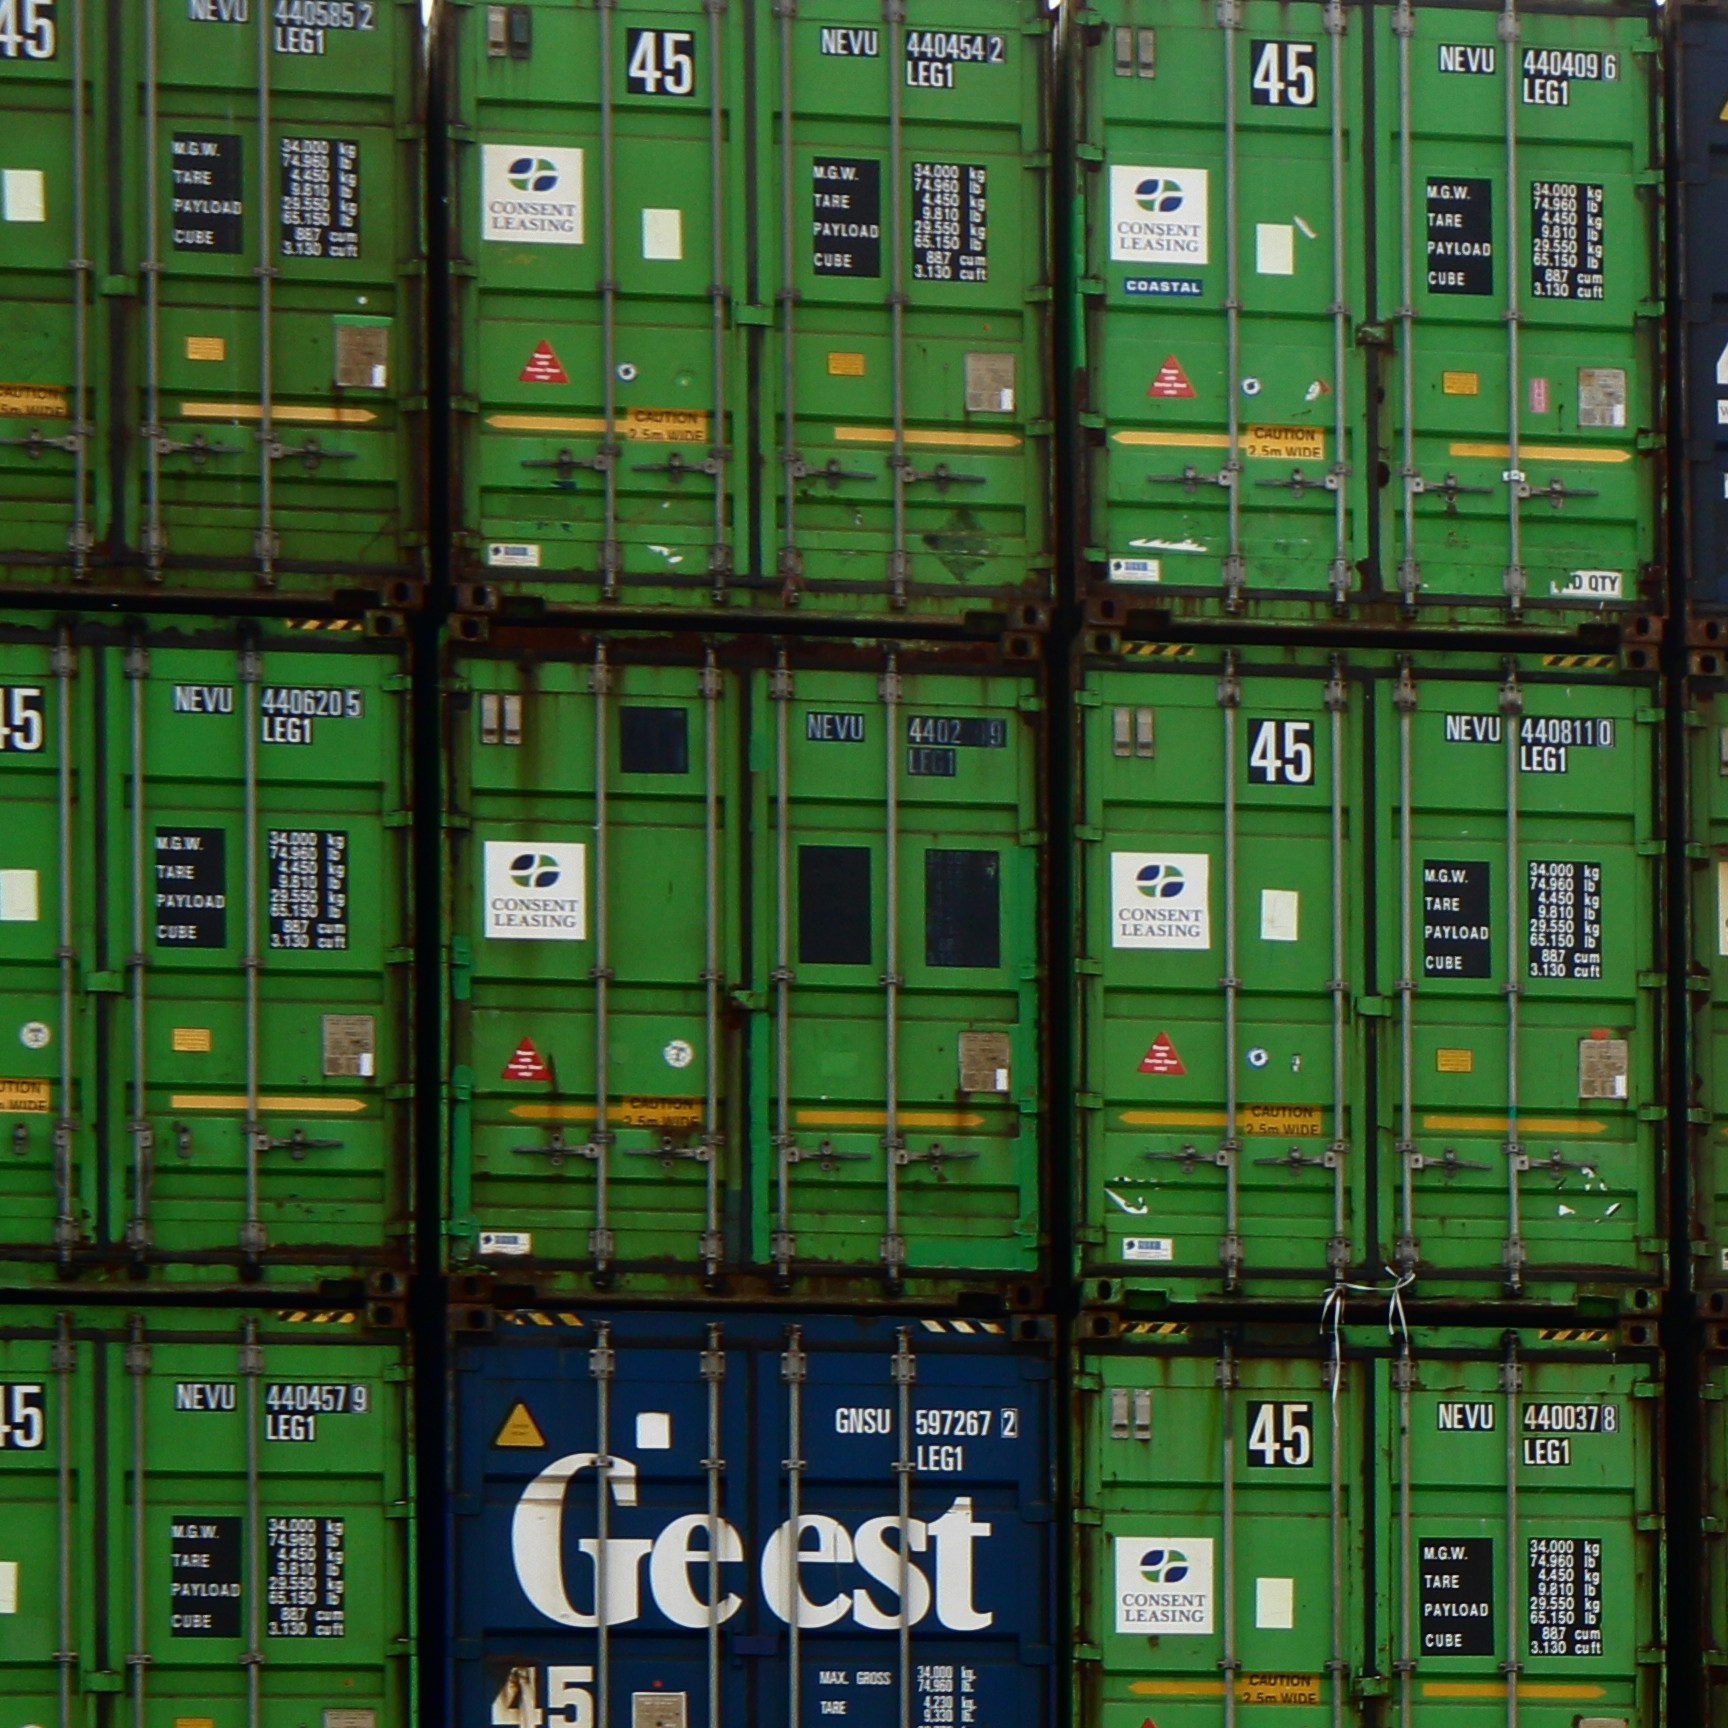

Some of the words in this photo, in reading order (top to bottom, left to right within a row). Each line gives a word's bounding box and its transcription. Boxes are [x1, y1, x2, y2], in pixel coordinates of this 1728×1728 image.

[823, 29, 877, 54] NEVU
[908, 33, 983, 64] 440454
[630, 32, 690, 93] 45
[908, 61, 952, 87] LEG1
[1254, 44, 1313, 104] 45
[1441, 46, 1493, 72] NEVU
[1525, 51, 1597, 80] 440409
[1524, 78, 1567, 104] LEG1
[1427, 186, 1471, 199] M.G.W.
[1534, 183, 1576, 197] 34.000
[1587, 185, 1602, 201] kg
[1118, 222, 1201, 237] CONSENT
[1428, 213, 1462, 226] TARE
[1120, 237, 1198, 252] LEASING
[1428, 242, 1491, 256] PAYLOAD
[1127, 281, 1200, 293] COASTAL
[1428, 272, 1465, 285] CUBE
[1589, 573, 1618, 592] QTY
[1251, 722, 1310, 782] 45
[178, 1384, 234, 1409] NEVU
[268, 1386, 345, 1410] 440457
[267, 1415, 313, 1440] LEG1
[836, 1408, 890, 1433] GNSU
[916, 1410, 991, 1435] 597267
[1250, 1405, 1309, 1464] 45
[918, 1446, 962, 1470] LEG1
[512, 1453, 993, 1630] Geest
[856, 1671, 891, 1686] GROSS
[820, 1701, 845, 1714] TARE
